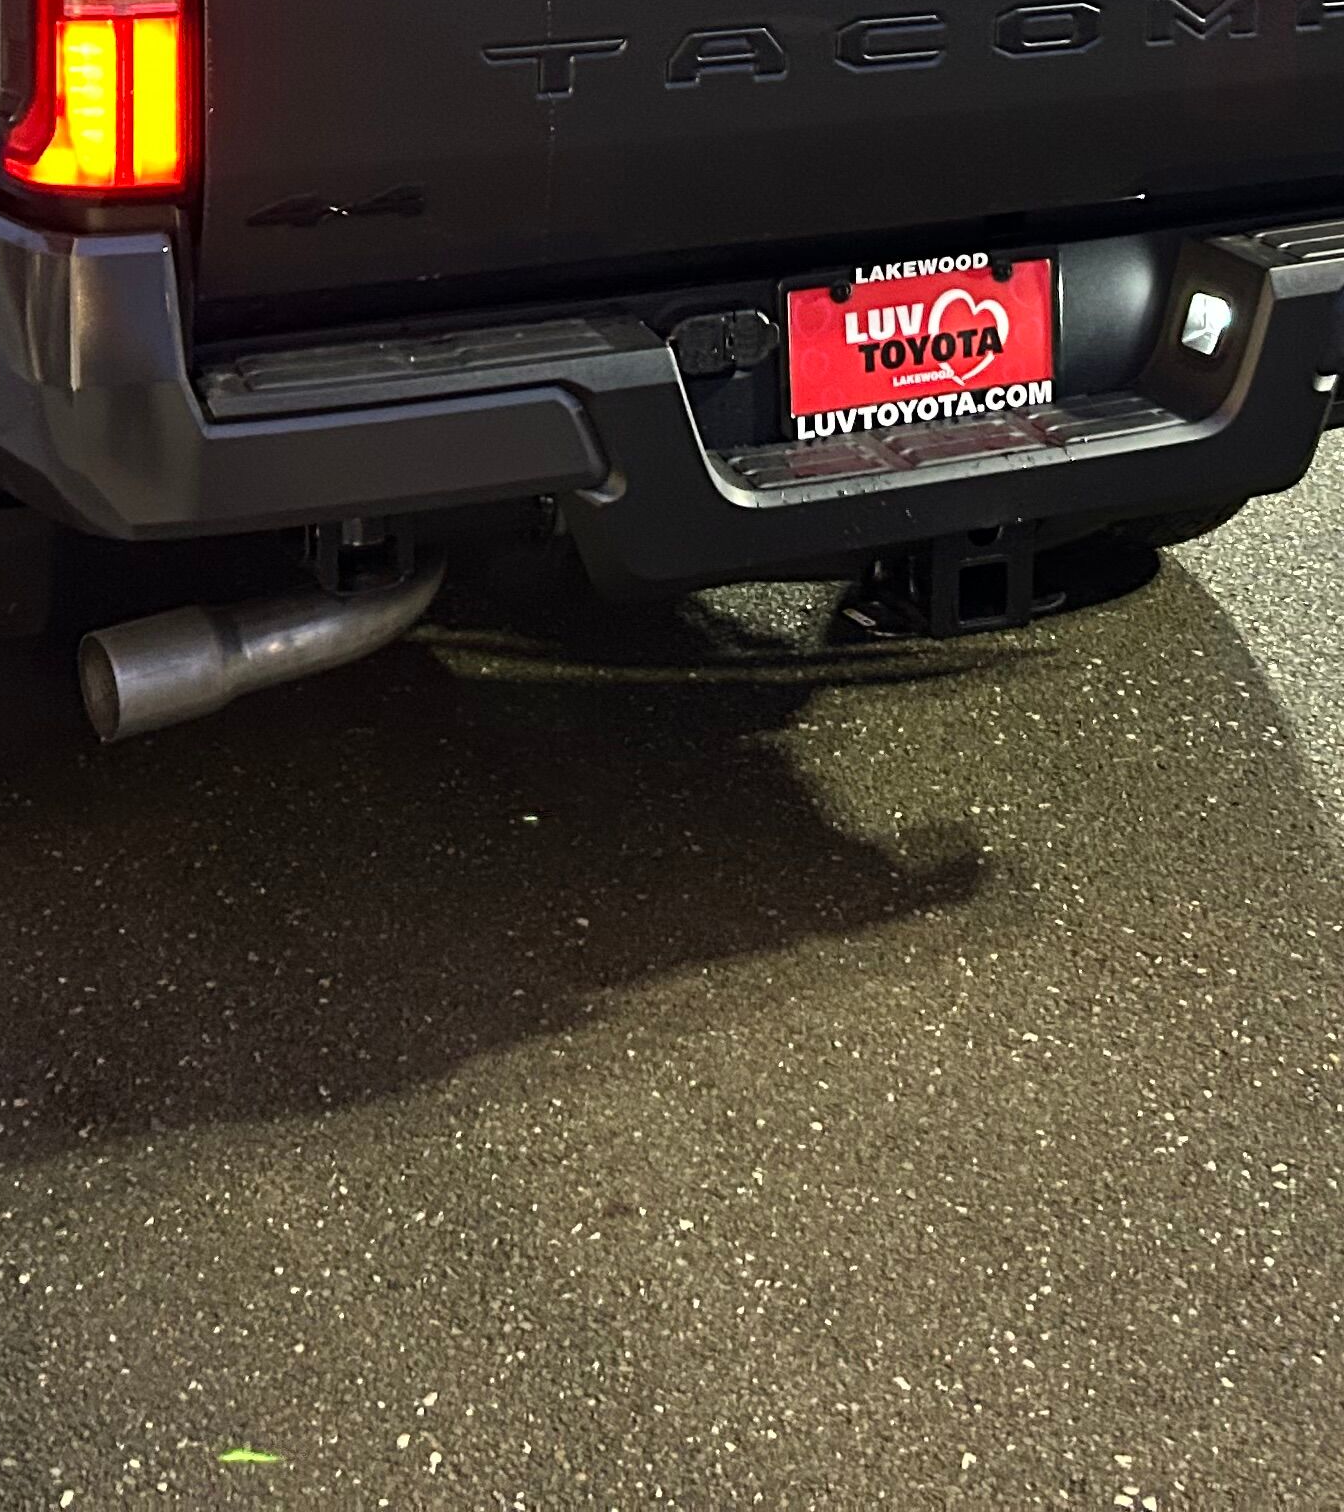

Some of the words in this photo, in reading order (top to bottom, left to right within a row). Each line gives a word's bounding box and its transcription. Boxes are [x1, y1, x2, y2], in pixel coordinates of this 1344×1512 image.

[855, 252, 989, 285] LAKEWOOD
[844, 302, 925, 345] LUV
[858, 326, 1004, 373] TOYOTA
[892, 367, 955, 388] LAKEWOOD
[797, 380, 1053, 441] LUVTOYOTA.COM
